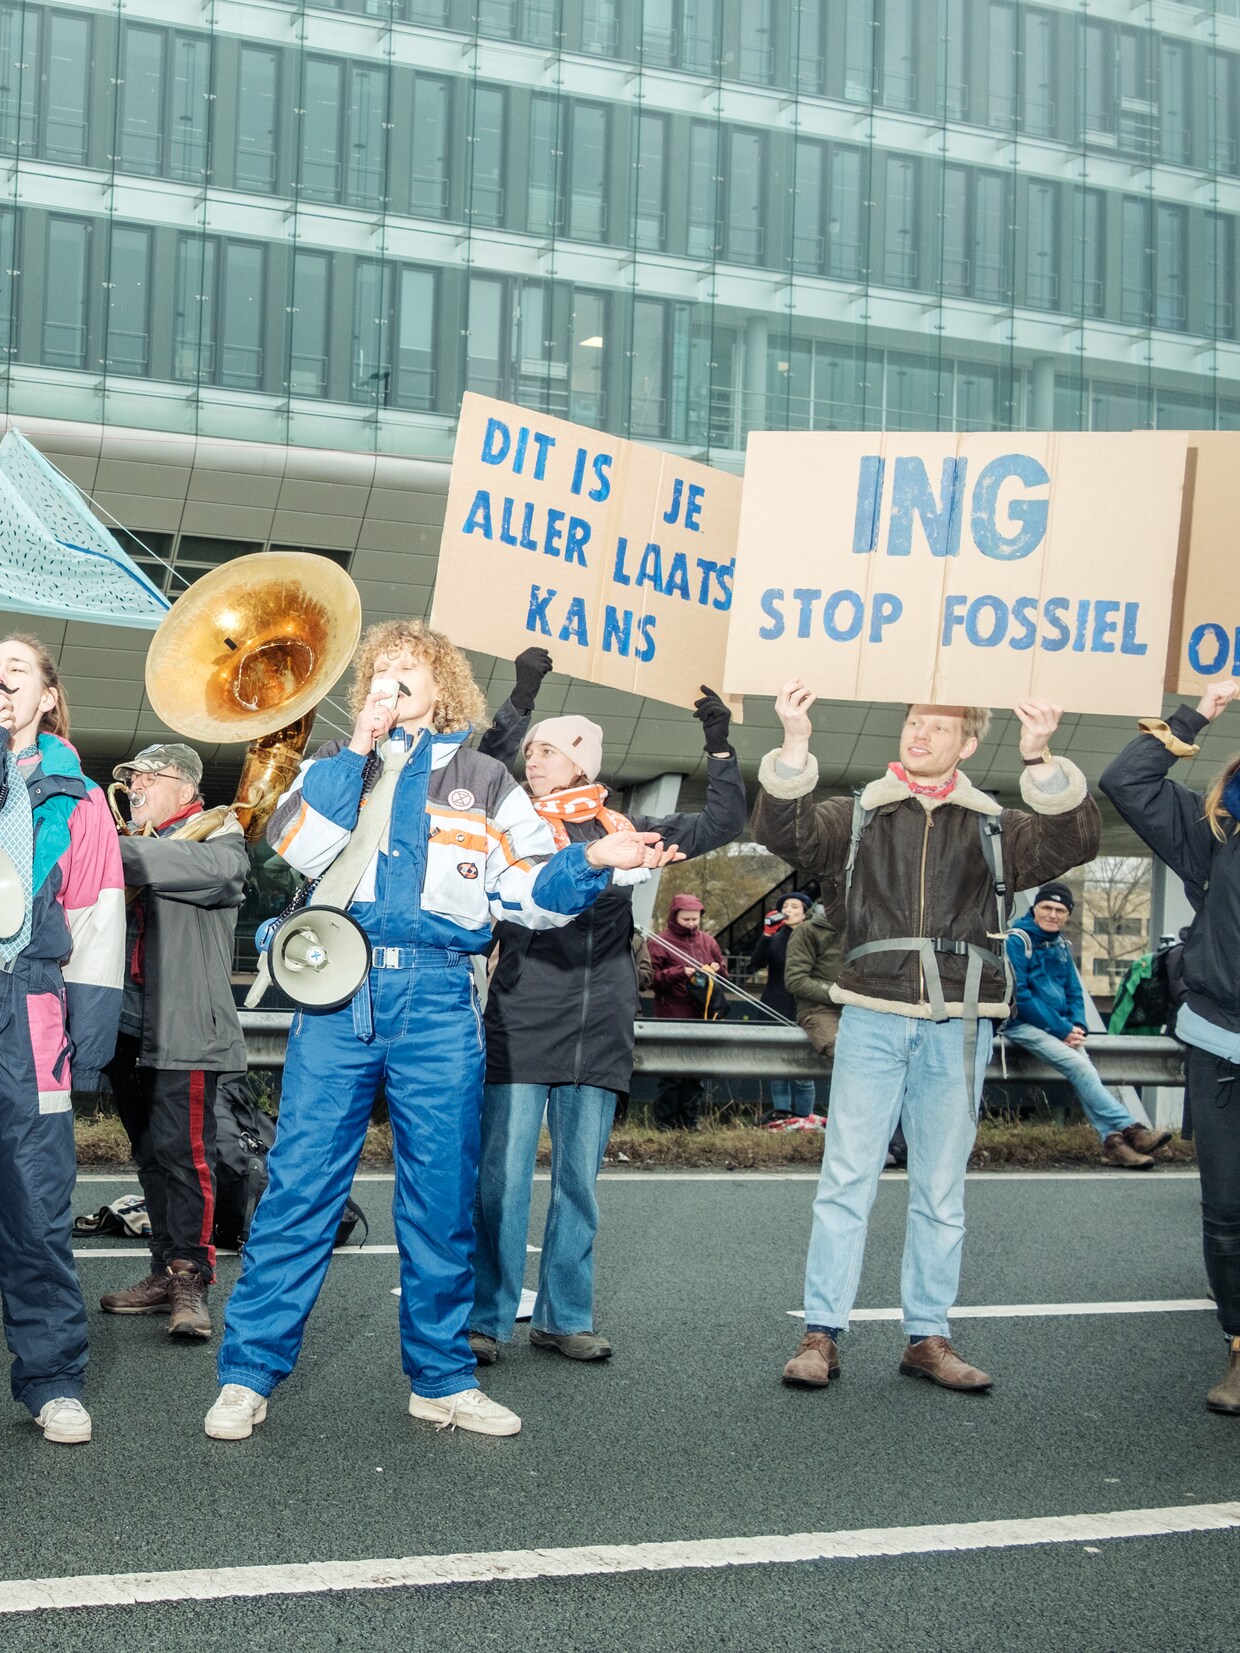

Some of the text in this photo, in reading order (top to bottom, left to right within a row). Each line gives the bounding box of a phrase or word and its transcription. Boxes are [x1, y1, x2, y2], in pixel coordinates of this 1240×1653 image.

[480, 417, 705, 532] DIT IS JE
[851, 452, 1052, 562] ING
[462, 489, 592, 568] ALLER
[526, 583, 657, 663] KANS
[759, 588, 1149, 656] STOP FOSSIEL
